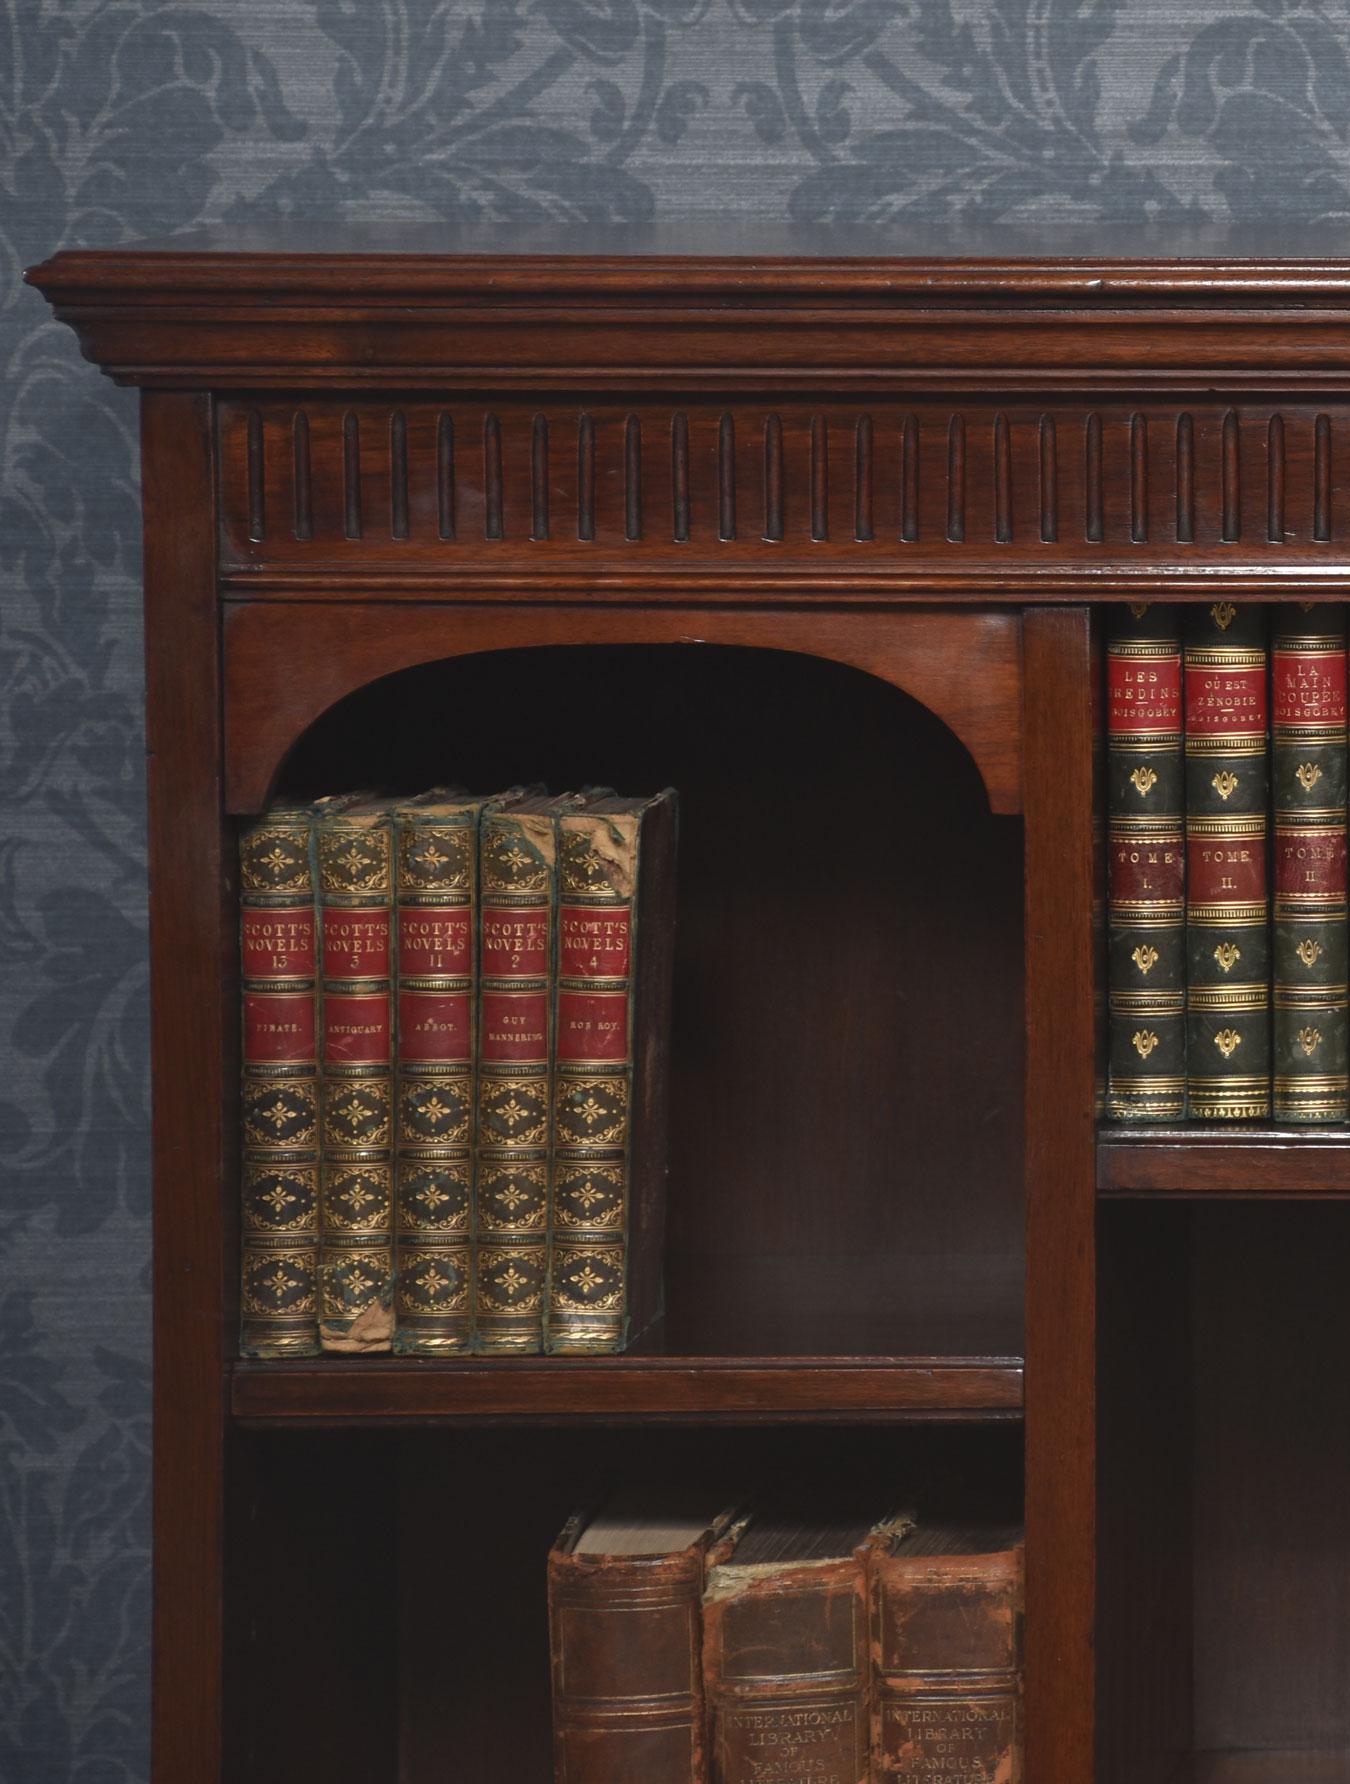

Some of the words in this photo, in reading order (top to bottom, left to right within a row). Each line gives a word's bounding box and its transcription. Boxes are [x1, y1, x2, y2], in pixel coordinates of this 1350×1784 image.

[1297, 664, 1319, 676] LA
[1125, 671, 1158, 682] LES
[1286, 676, 1331, 688] MAIN
[1225, 680, 1248, 690] EST
[1118, 852, 1173, 864] TOME
[1285, 847, 1335, 859] TOME
[1221, 877, 1237, 889] II.
[247, 939, 309, 951] NOVELS
[404, 937, 465, 950] NOVELS
[485, 939, 545, 951] NOVELS
[564, 937, 625, 950] NOVELS
[511, 955, 520, 968] 2
[589, 956, 599, 968] 4
[502, 1016, 526, 1025] GUY
[570, 1021, 591, 1030] ROB
[908, 1728, 986, 1740] LIBRARY
[936, 1744, 955, 1753] OF
